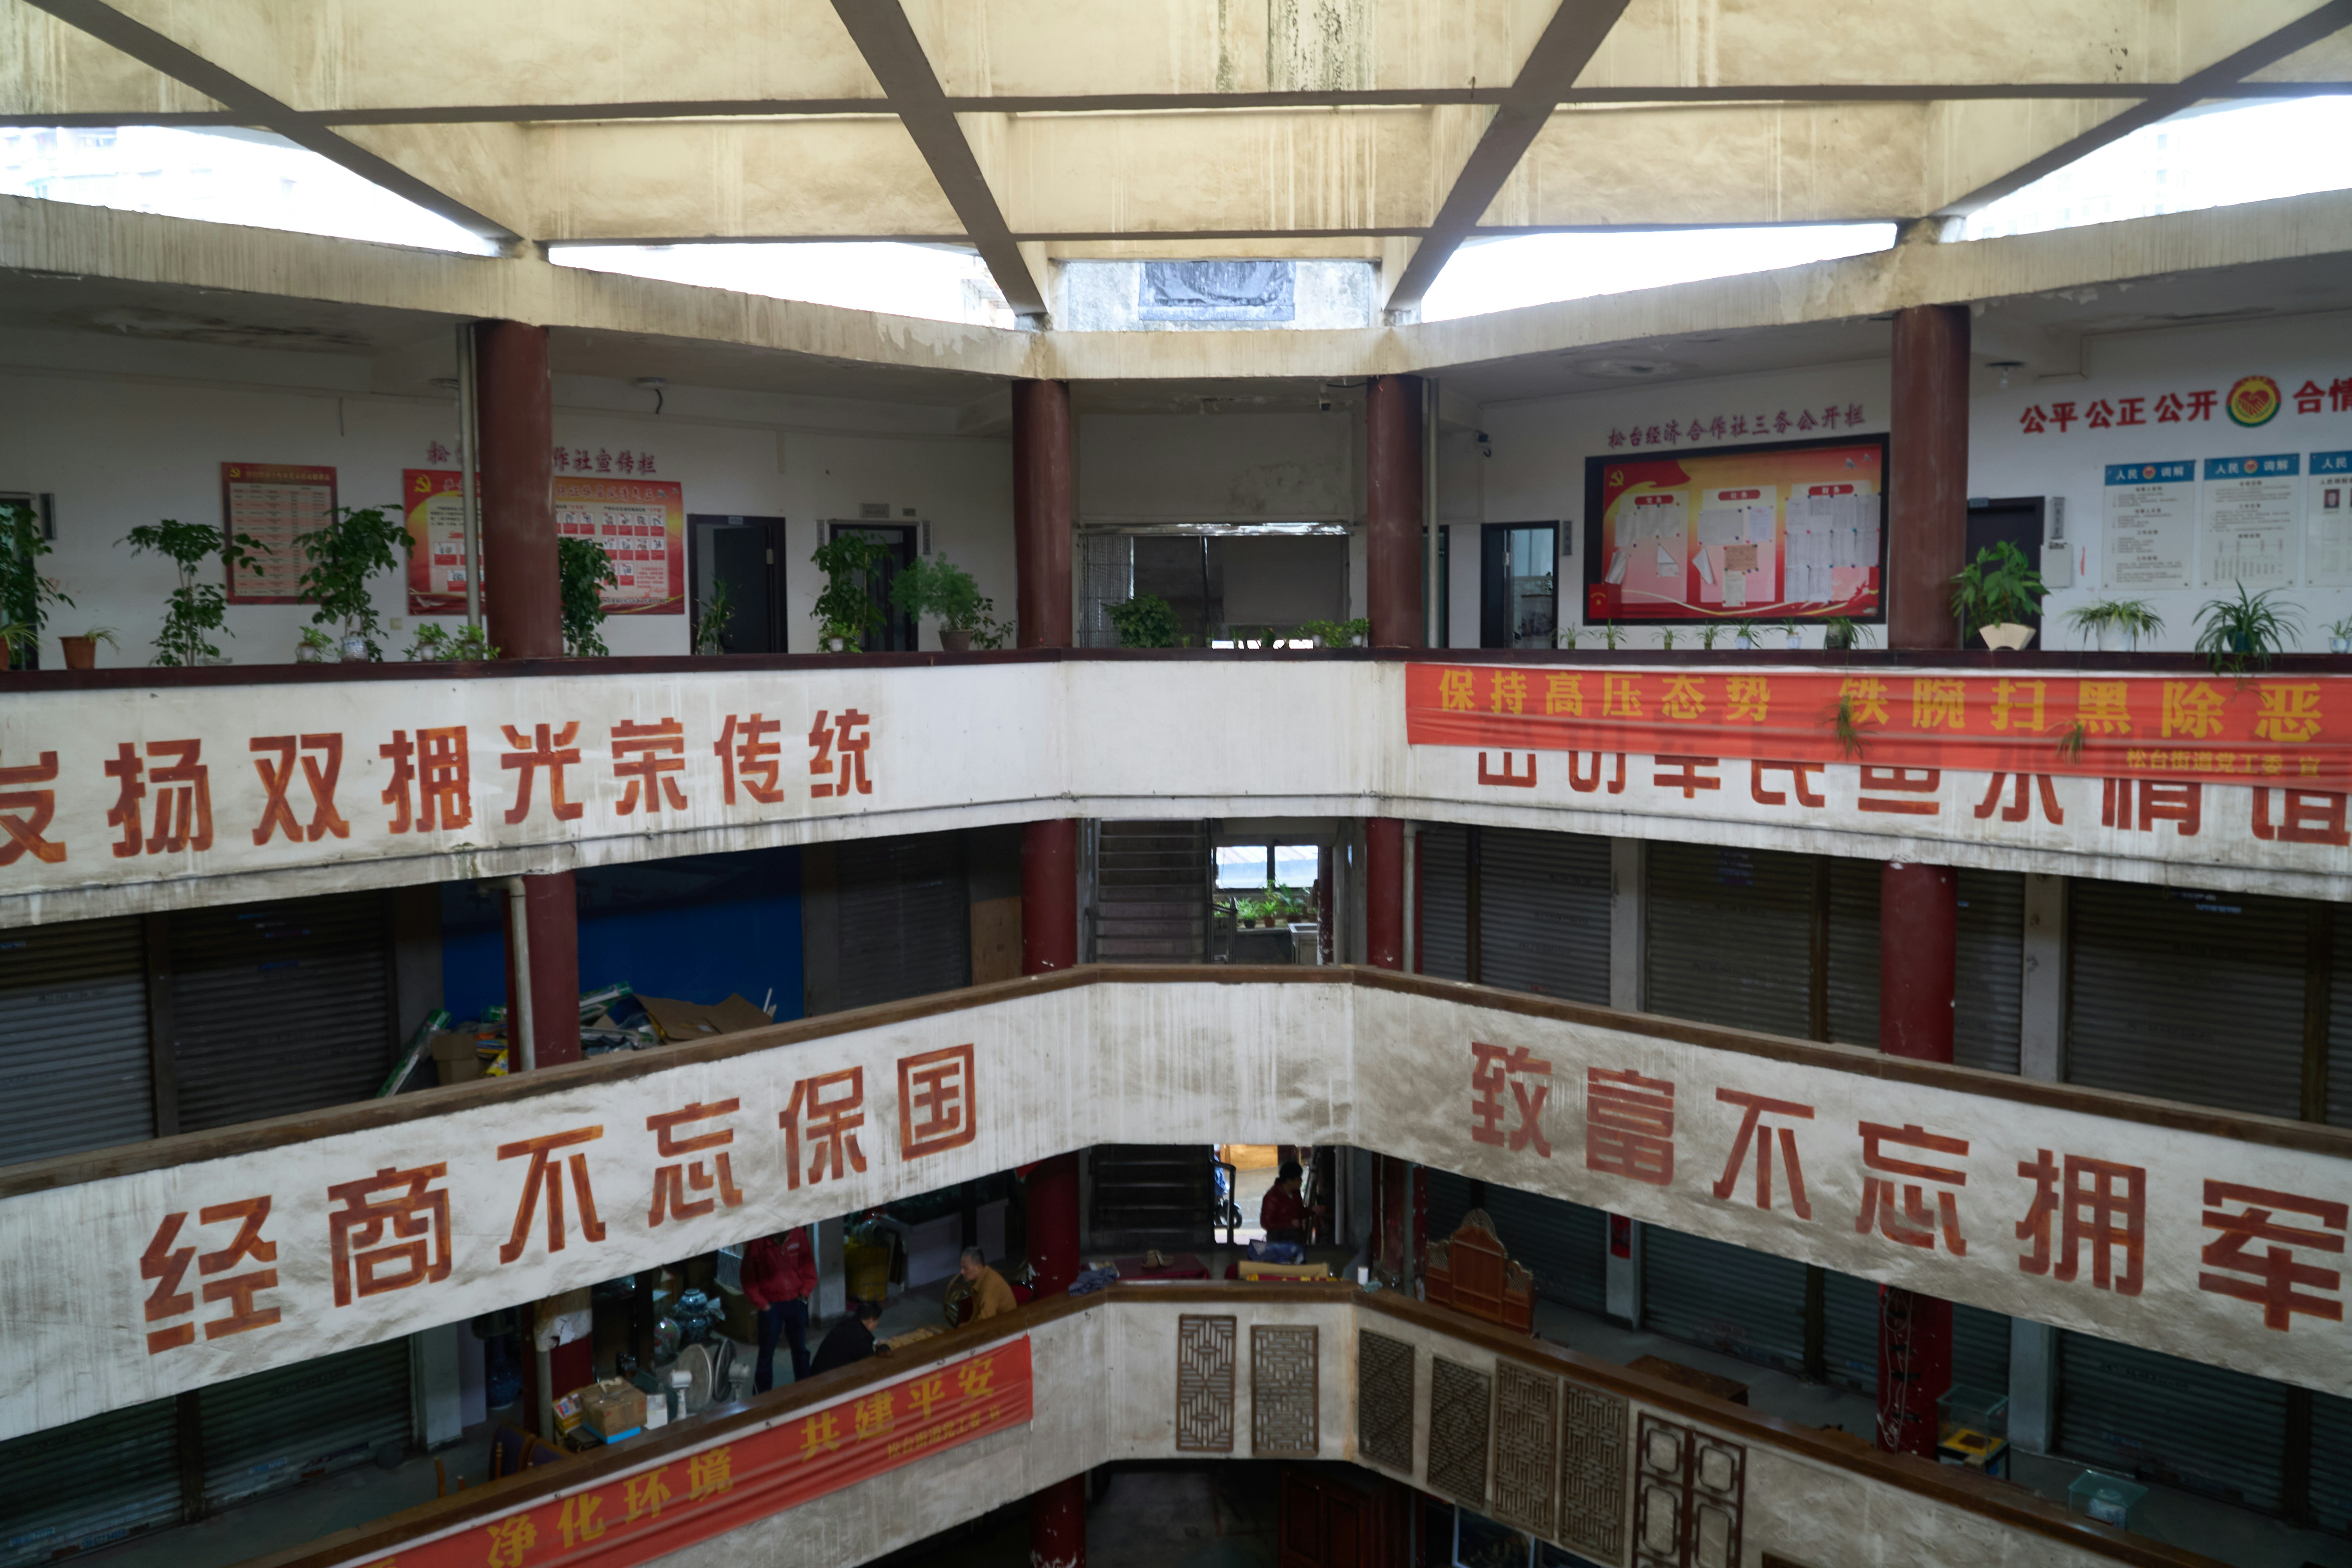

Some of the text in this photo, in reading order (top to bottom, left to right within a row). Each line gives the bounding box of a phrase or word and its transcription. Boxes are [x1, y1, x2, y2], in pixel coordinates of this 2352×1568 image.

[1608, 403, 1866, 449] 松台经济合作社三务公开栏
[2020, 377, 2352, 435] 公平公正公开 合情
[2116, 468, 2138, 480] 人民
[2215, 462, 2238, 474] 人民
[2321, 457, 2347, 469] 人民
[1439, 669, 2322, 743] 保持高压态势 铁腕扫黑除恶
[0, 708, 873, 867] 发扬双拥光荣传统
[2126, 748, 2321, 778] 松台街道党工委 宣
[140, 1043, 977, 1355] 经商不忘保国
[1472, 1041, 2348, 1332] 致富不忘拥军
[486, 1358, 994, 1568] 净化环境 共建平安
